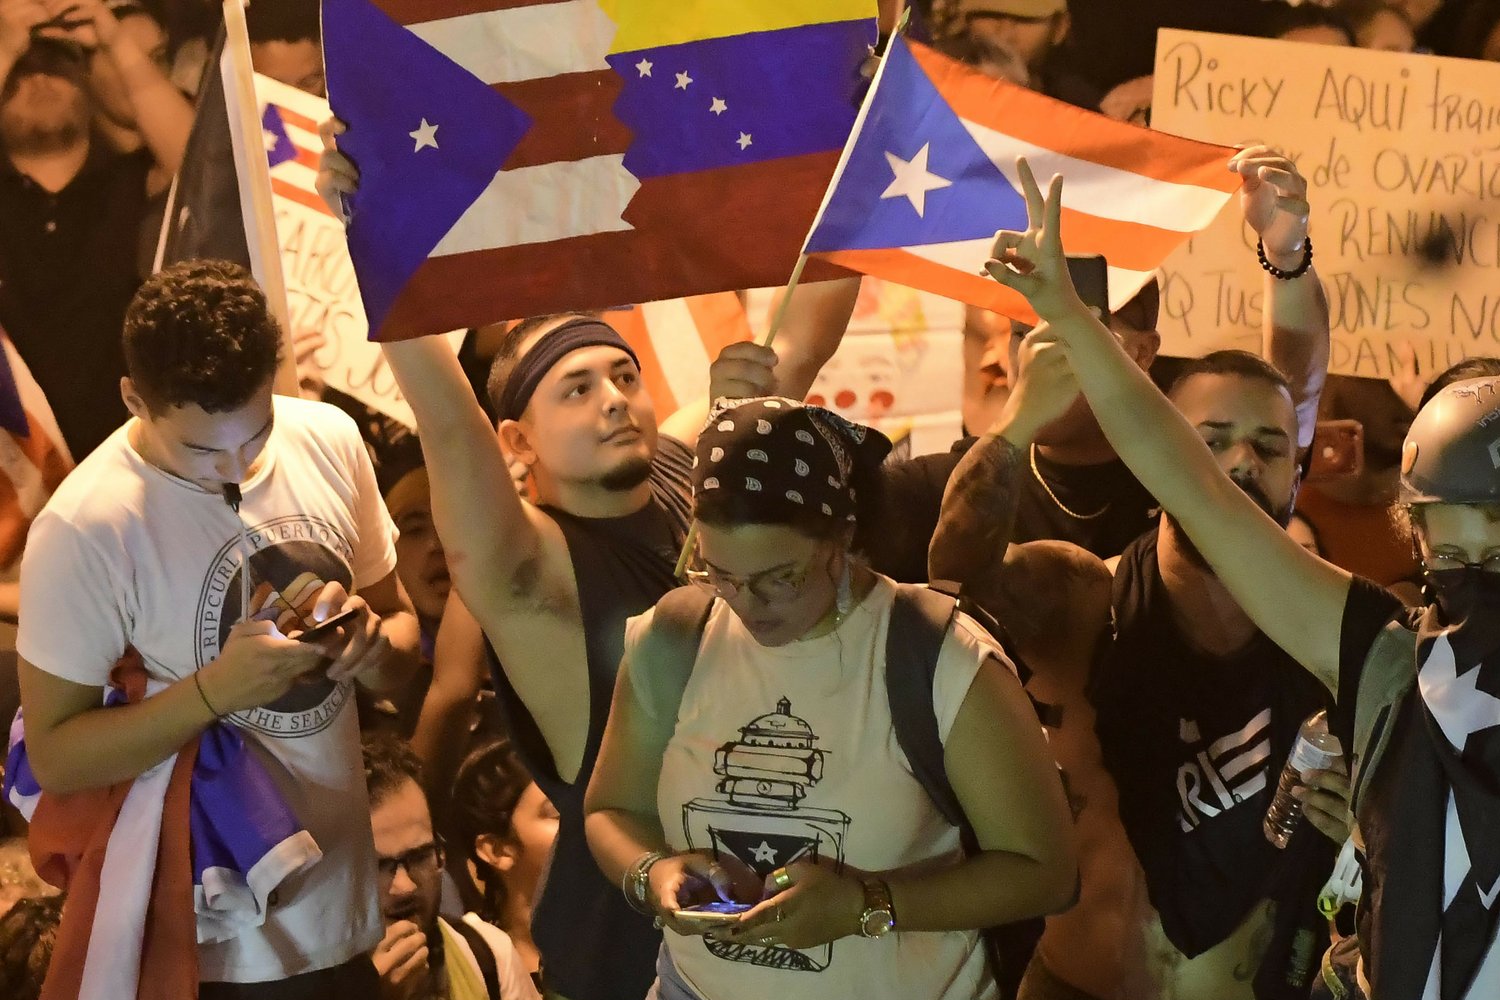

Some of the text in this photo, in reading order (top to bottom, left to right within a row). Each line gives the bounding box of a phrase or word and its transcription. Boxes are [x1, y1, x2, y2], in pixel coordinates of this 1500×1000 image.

[1313, 138, 1350, 189] de
[250, 524, 330, 551] PUERTO
[203, 556, 240, 649] RIPCURL
[245, 708, 283, 730] THE
